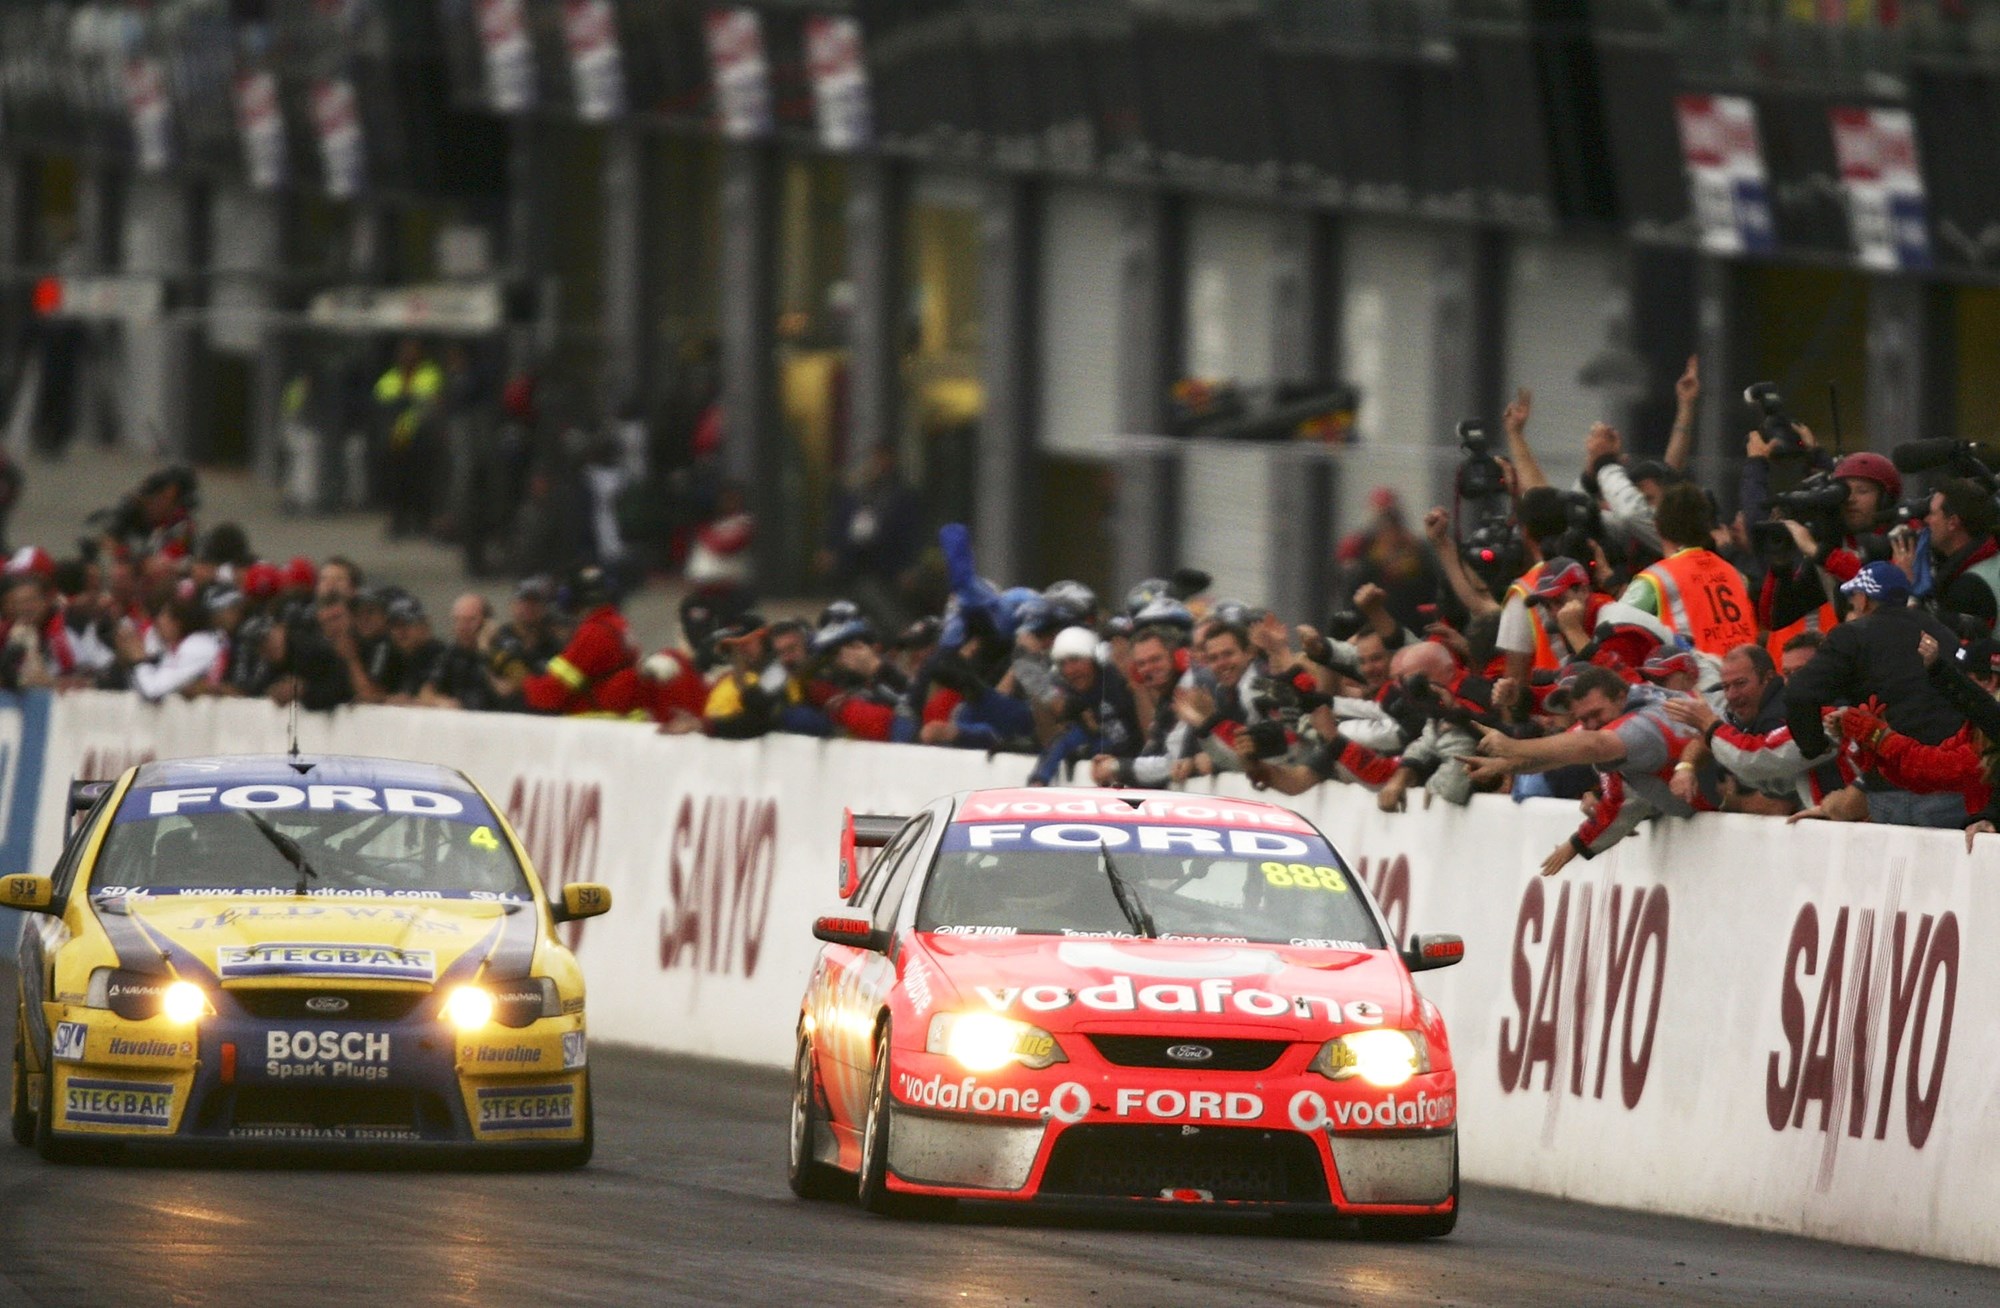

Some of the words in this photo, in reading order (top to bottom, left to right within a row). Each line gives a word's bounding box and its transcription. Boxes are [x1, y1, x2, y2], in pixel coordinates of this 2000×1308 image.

[1703, 584, 1742, 624] 16
[150, 785, 464, 815] FORD
[974, 799, 1295, 827] vodafone
[469, 826, 499, 850] 4
[969, 824, 1309, 856] FORD
[659, 792, 778, 979] SANYO
[1261, 862, 1348, 892] 888
[828, 918, 870, 935] DEXION
[1061, 928, 1248, 944] TeamVodfone.com
[231, 948, 424, 967] STEGBAR
[975, 975, 1385, 1025] vodafone
[1498, 875, 1670, 1110] SANYO
[1766, 902, 1960, 1150] SANYO
[109, 1037, 176, 1057] Havoline
[267, 1030, 390, 1061] BOSCH
[476, 1045, 542, 1064] Havoline
[266, 1060, 326, 1079] Spark
[332, 1061, 389, 1080] Plugs
[68, 1089, 168, 1116] STEGBAR
[905, 1073, 1042, 1114] vodafone
[1116, 1087, 1264, 1120] FORD
[1333, 1090, 1452, 1127] vodafone
[481, 1098, 572, 1120] STEGBAR
